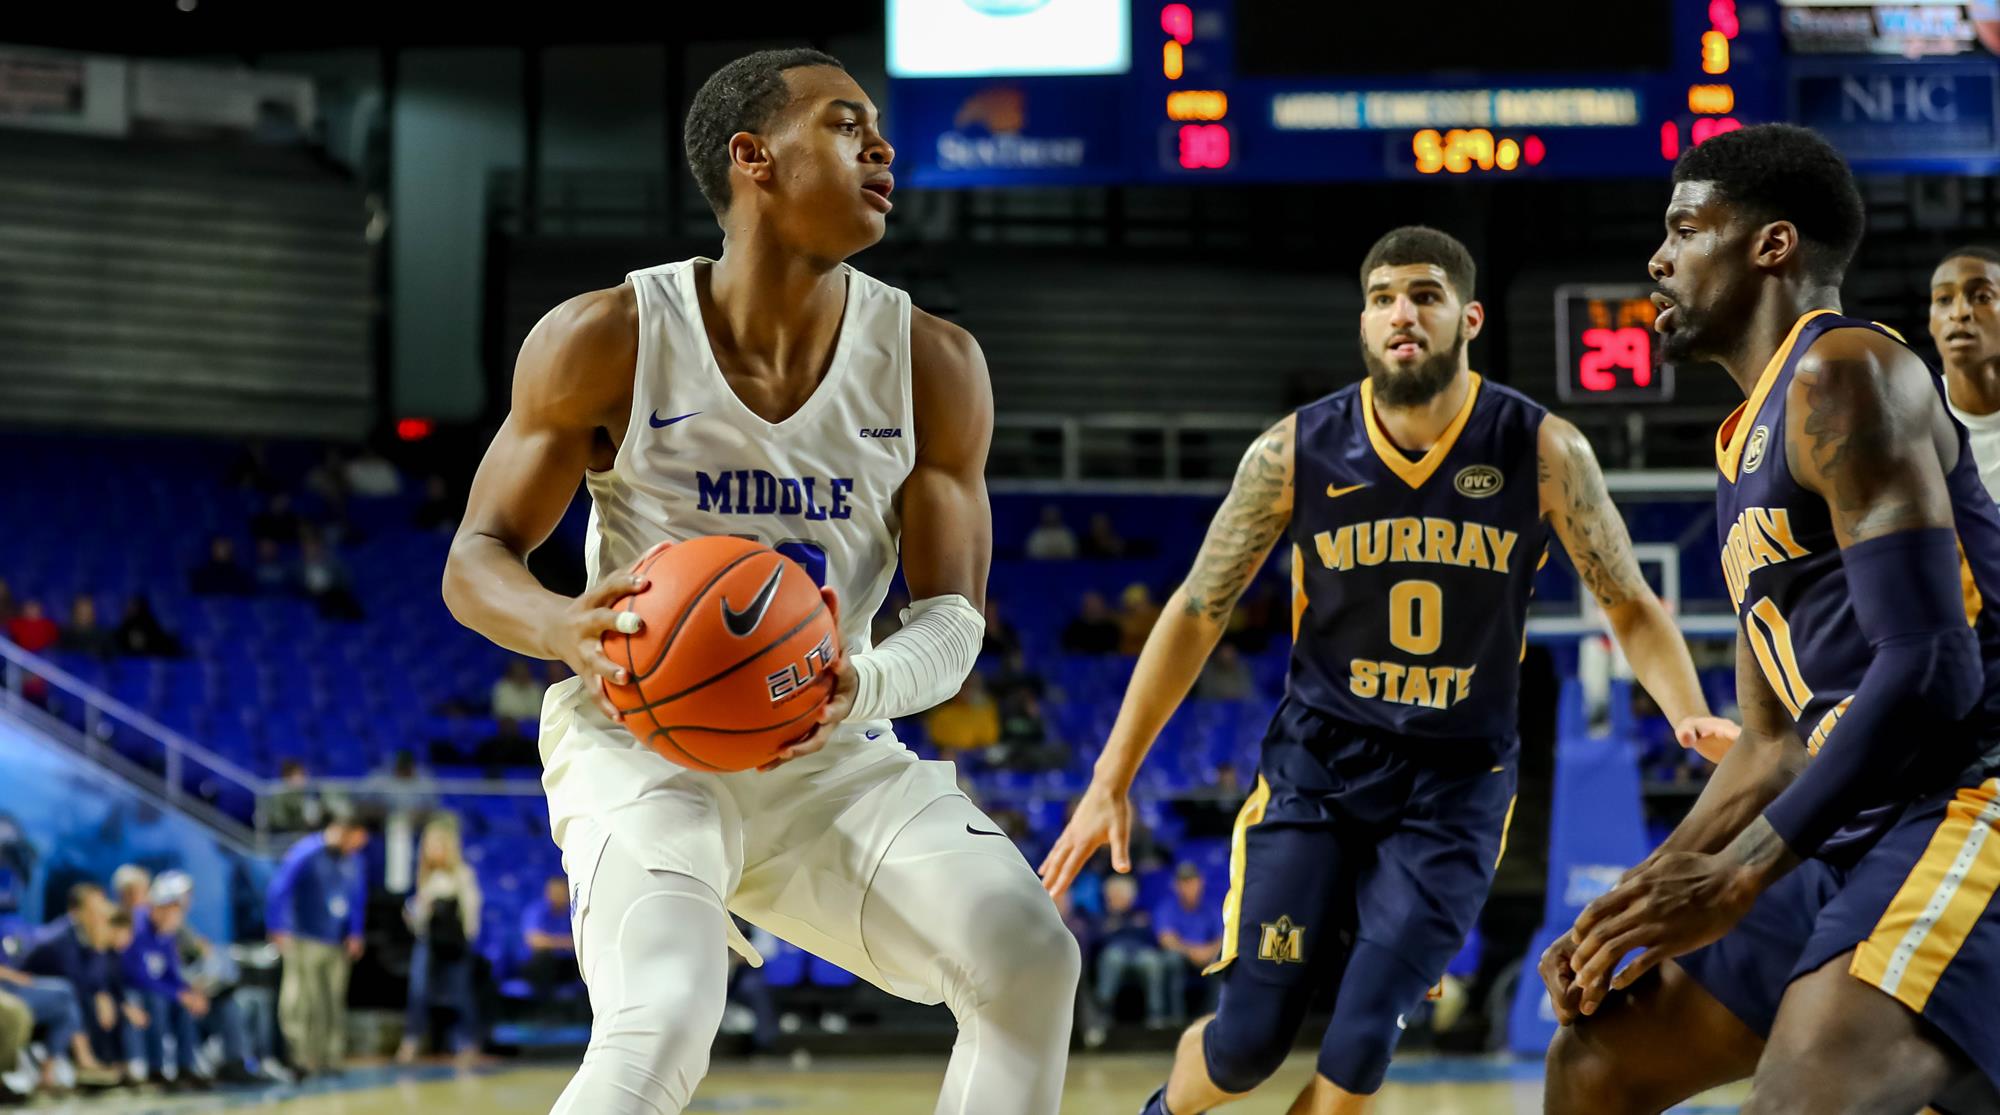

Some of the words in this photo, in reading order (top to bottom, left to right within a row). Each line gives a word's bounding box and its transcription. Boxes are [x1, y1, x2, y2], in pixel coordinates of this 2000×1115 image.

[1841, 74, 1957, 122] NHC
[1580, 328, 1651, 391] 29
[696, 470, 854, 521] MIDDLE
[1464, 475, 1492, 488] OVC
[1314, 517, 1519, 574] MURRAY
[1389, 579, 1443, 655] 0
[766, 632, 834, 702] ELITE
[1350, 658, 1477, 710] STATE
